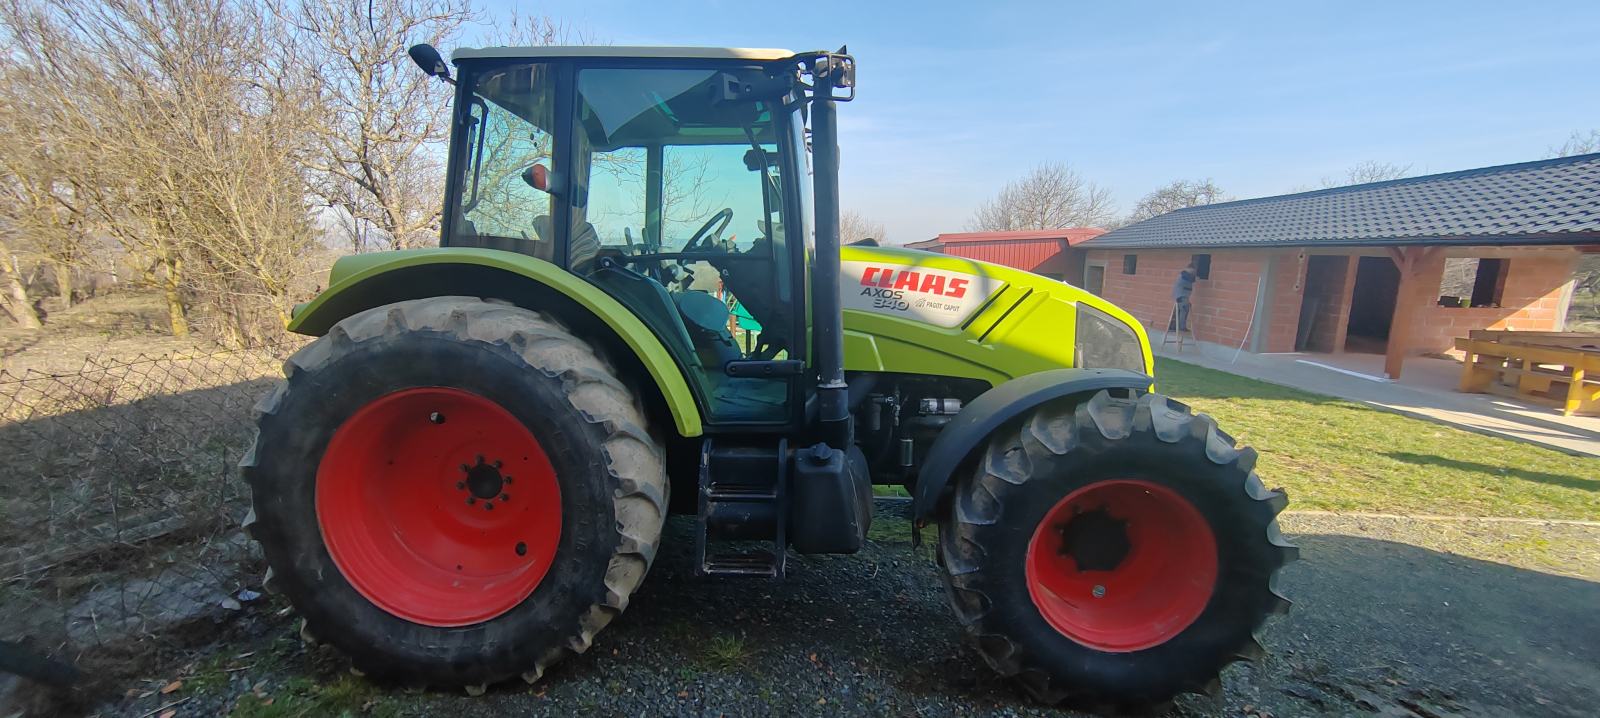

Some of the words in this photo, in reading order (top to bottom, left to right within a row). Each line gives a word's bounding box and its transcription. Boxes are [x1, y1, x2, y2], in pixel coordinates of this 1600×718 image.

[860, 267, 969, 298] CLAAS
[860, 287, 904, 299] AXOS
[873, 298, 910, 311] 340
